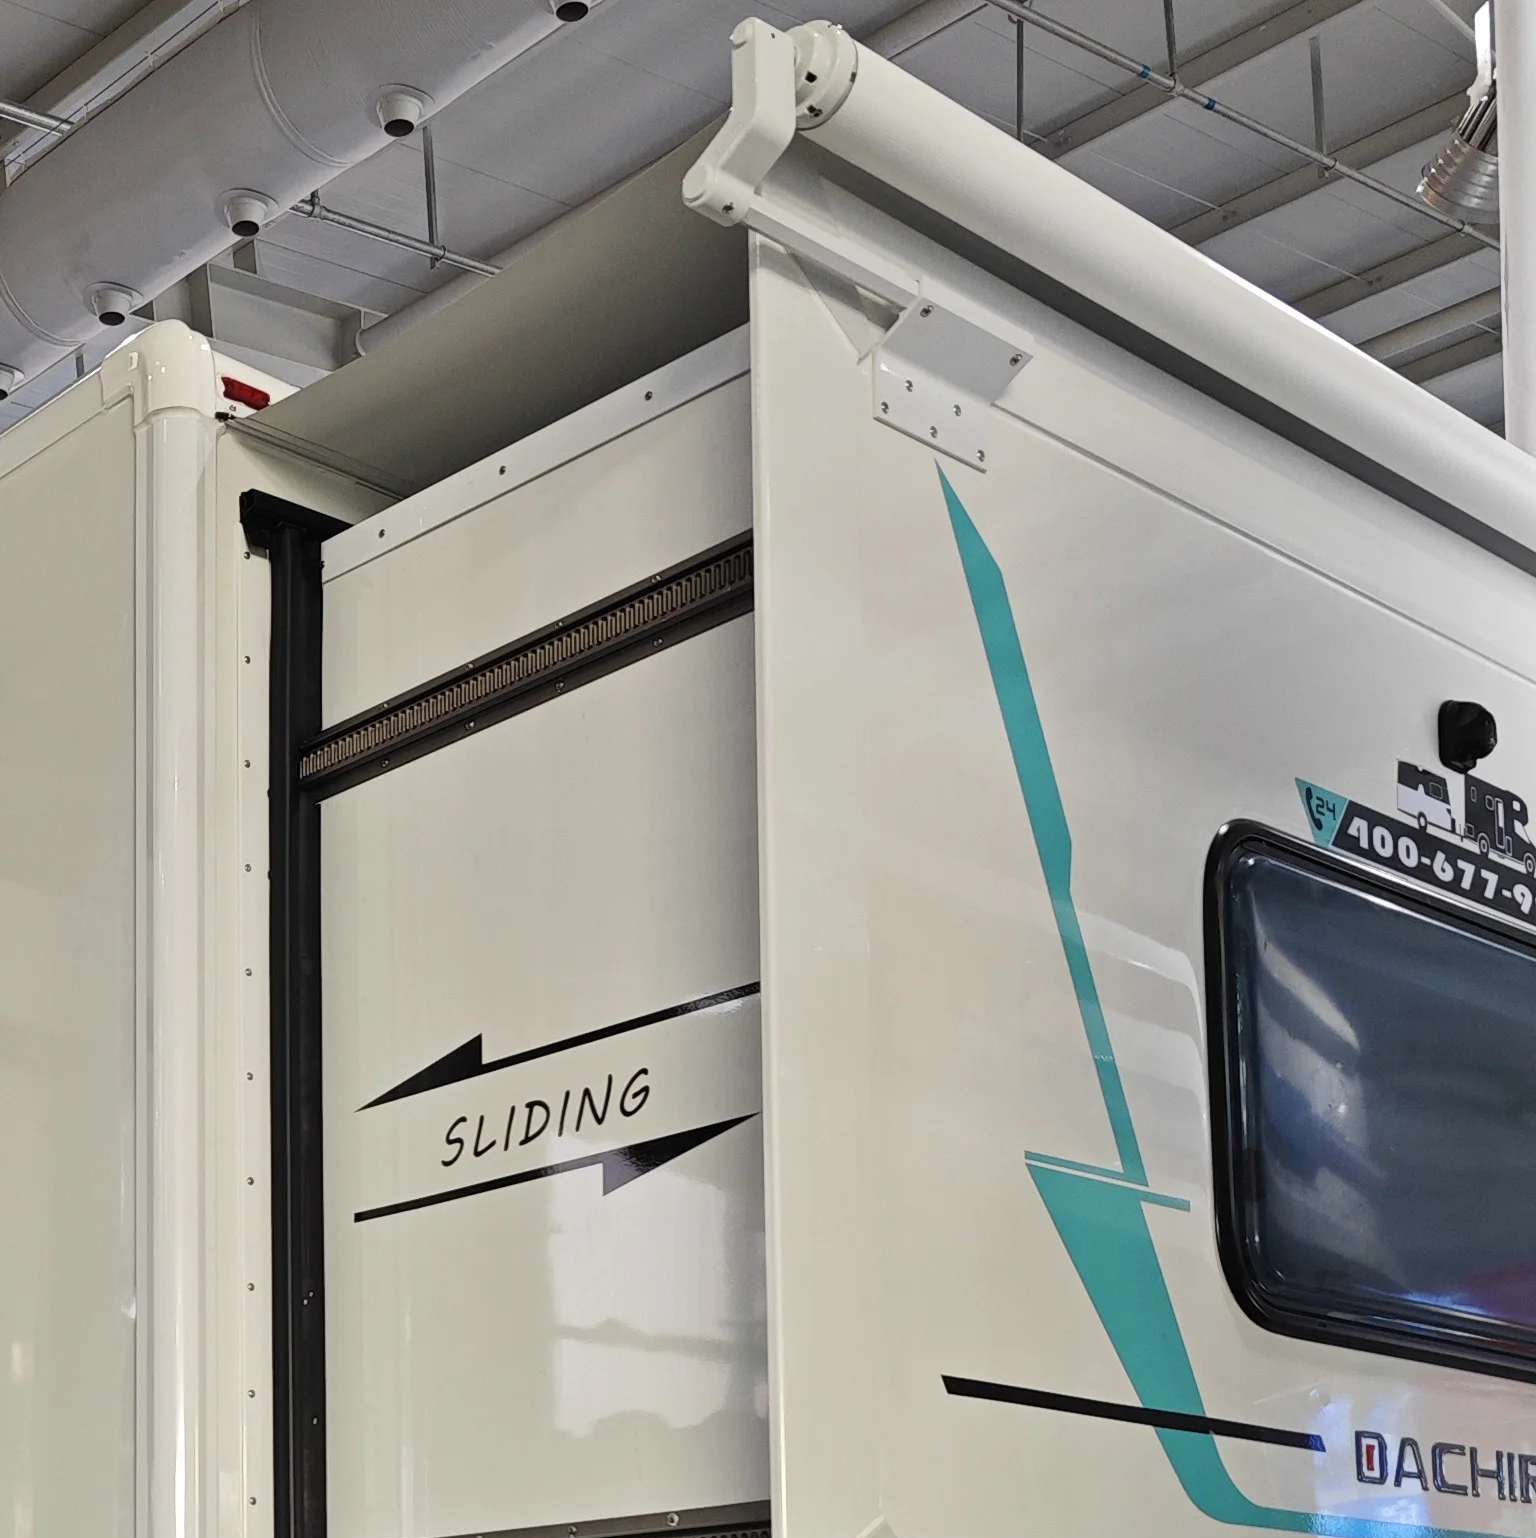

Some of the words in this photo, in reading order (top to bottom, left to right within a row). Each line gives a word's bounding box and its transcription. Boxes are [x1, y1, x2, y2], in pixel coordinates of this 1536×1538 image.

[1315, 796, 1337, 821] 24
[1346, 816, 1536, 915] 400-677-9
[441, 1067, 650, 1168] SLIDING
[1354, 1430, 1536, 1504] DACHIR
